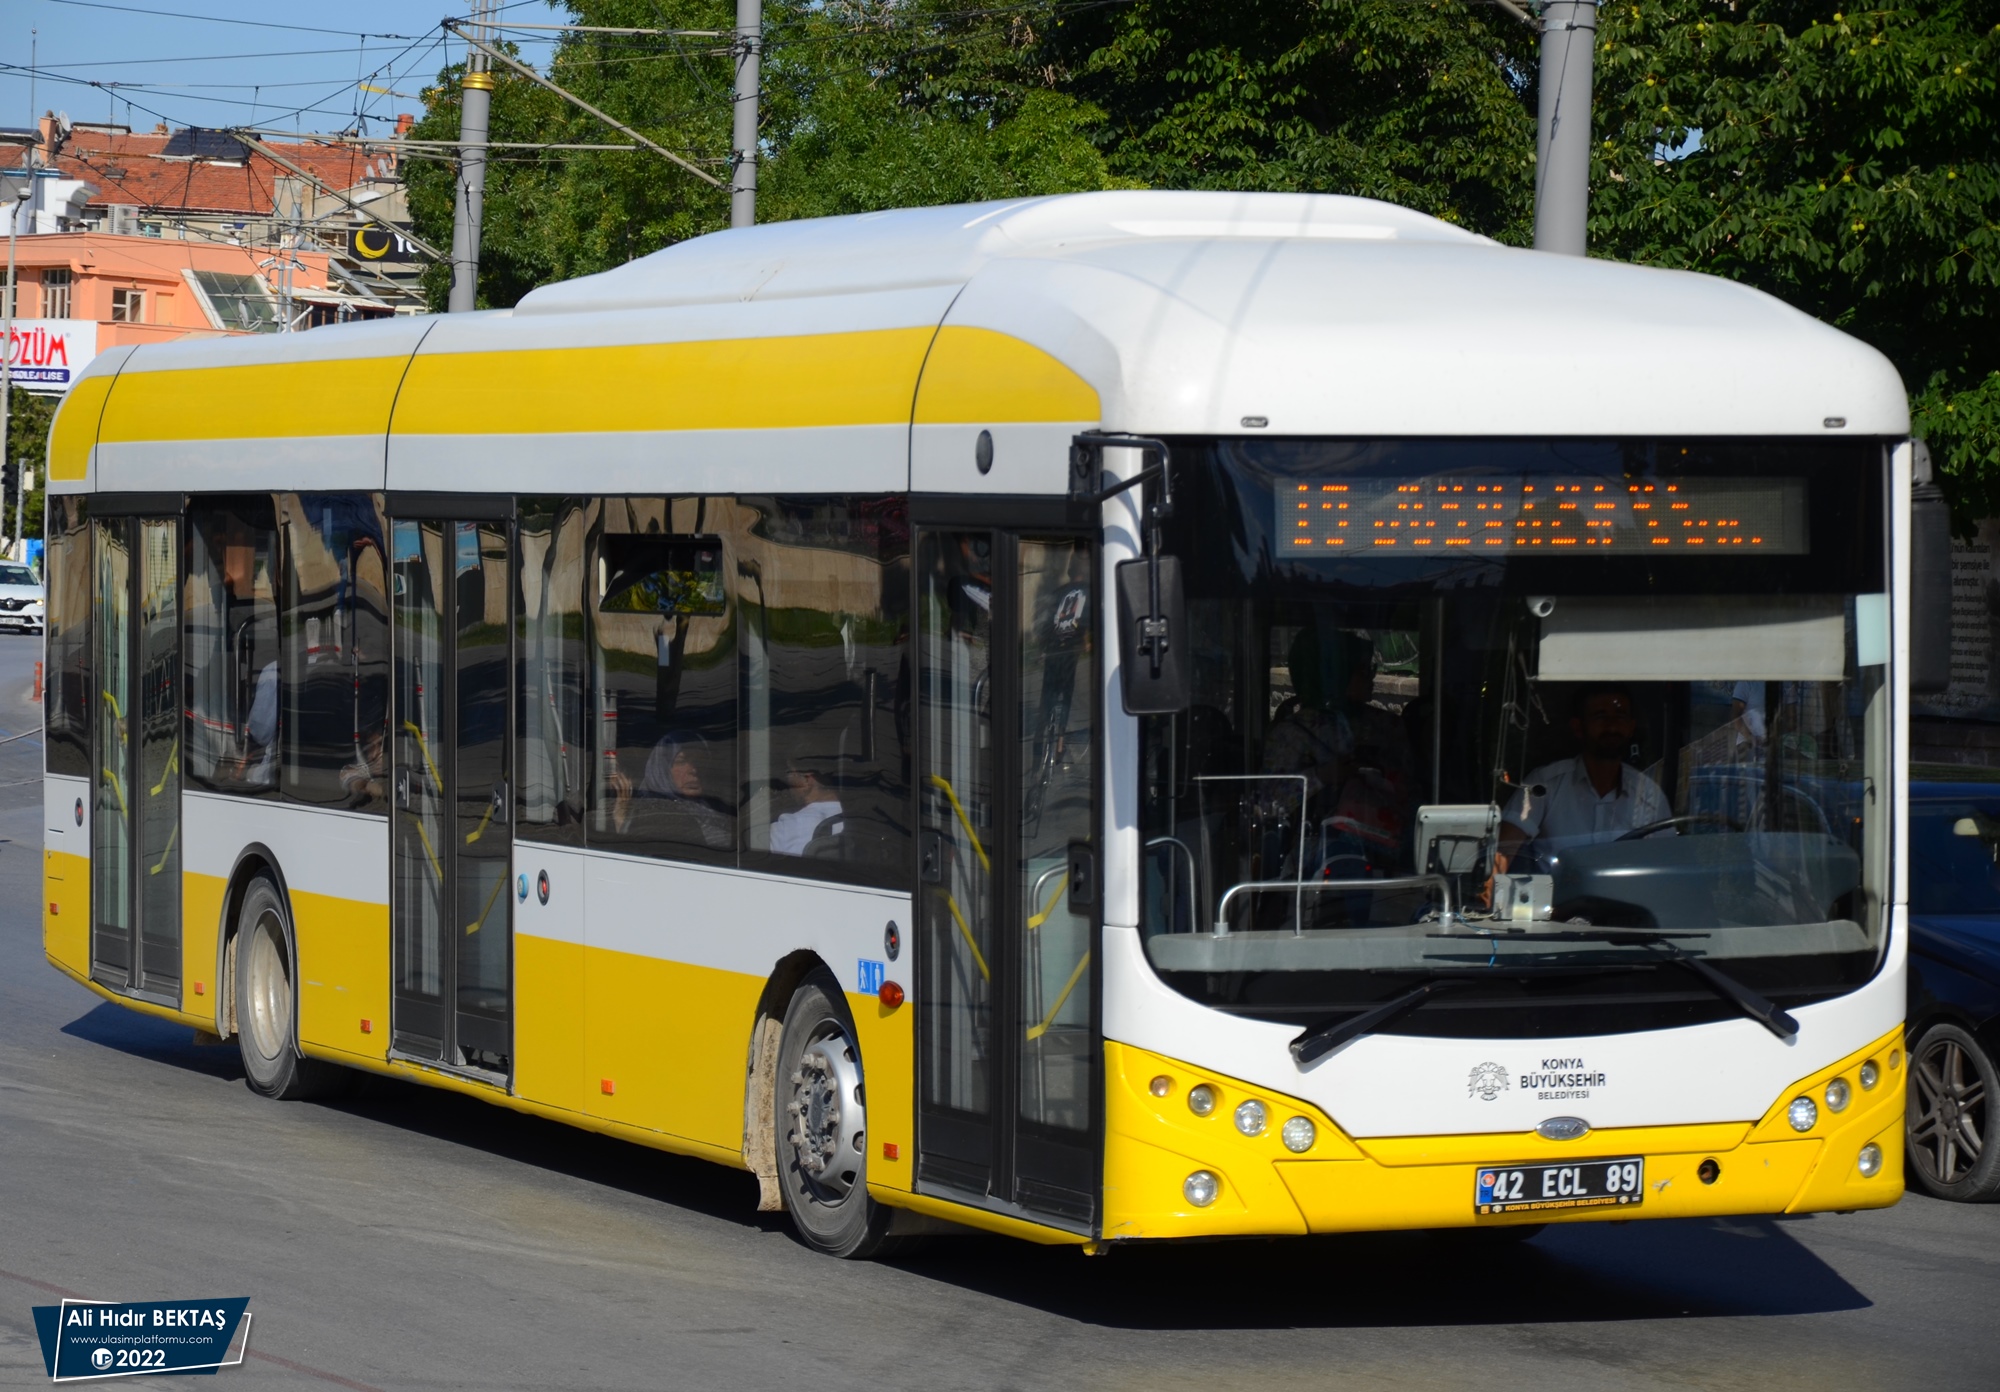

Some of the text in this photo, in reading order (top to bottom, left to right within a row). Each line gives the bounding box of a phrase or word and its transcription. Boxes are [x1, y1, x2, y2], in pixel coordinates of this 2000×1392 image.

[0, 326, 68, 366] ÖZÜM
[1541, 1058, 1584, 1070] KONYA
[1520, 1072, 1606, 1089] BÜYÜKŞEHİR
[1538, 1089, 1590, 1100] BELEDİYESİ
[1493, 1164, 1637, 1200] 42 ECL 89
[1505, 1197, 1617, 1211] KONYA BÜYÜKŞEHİR BELEDİYESİ
